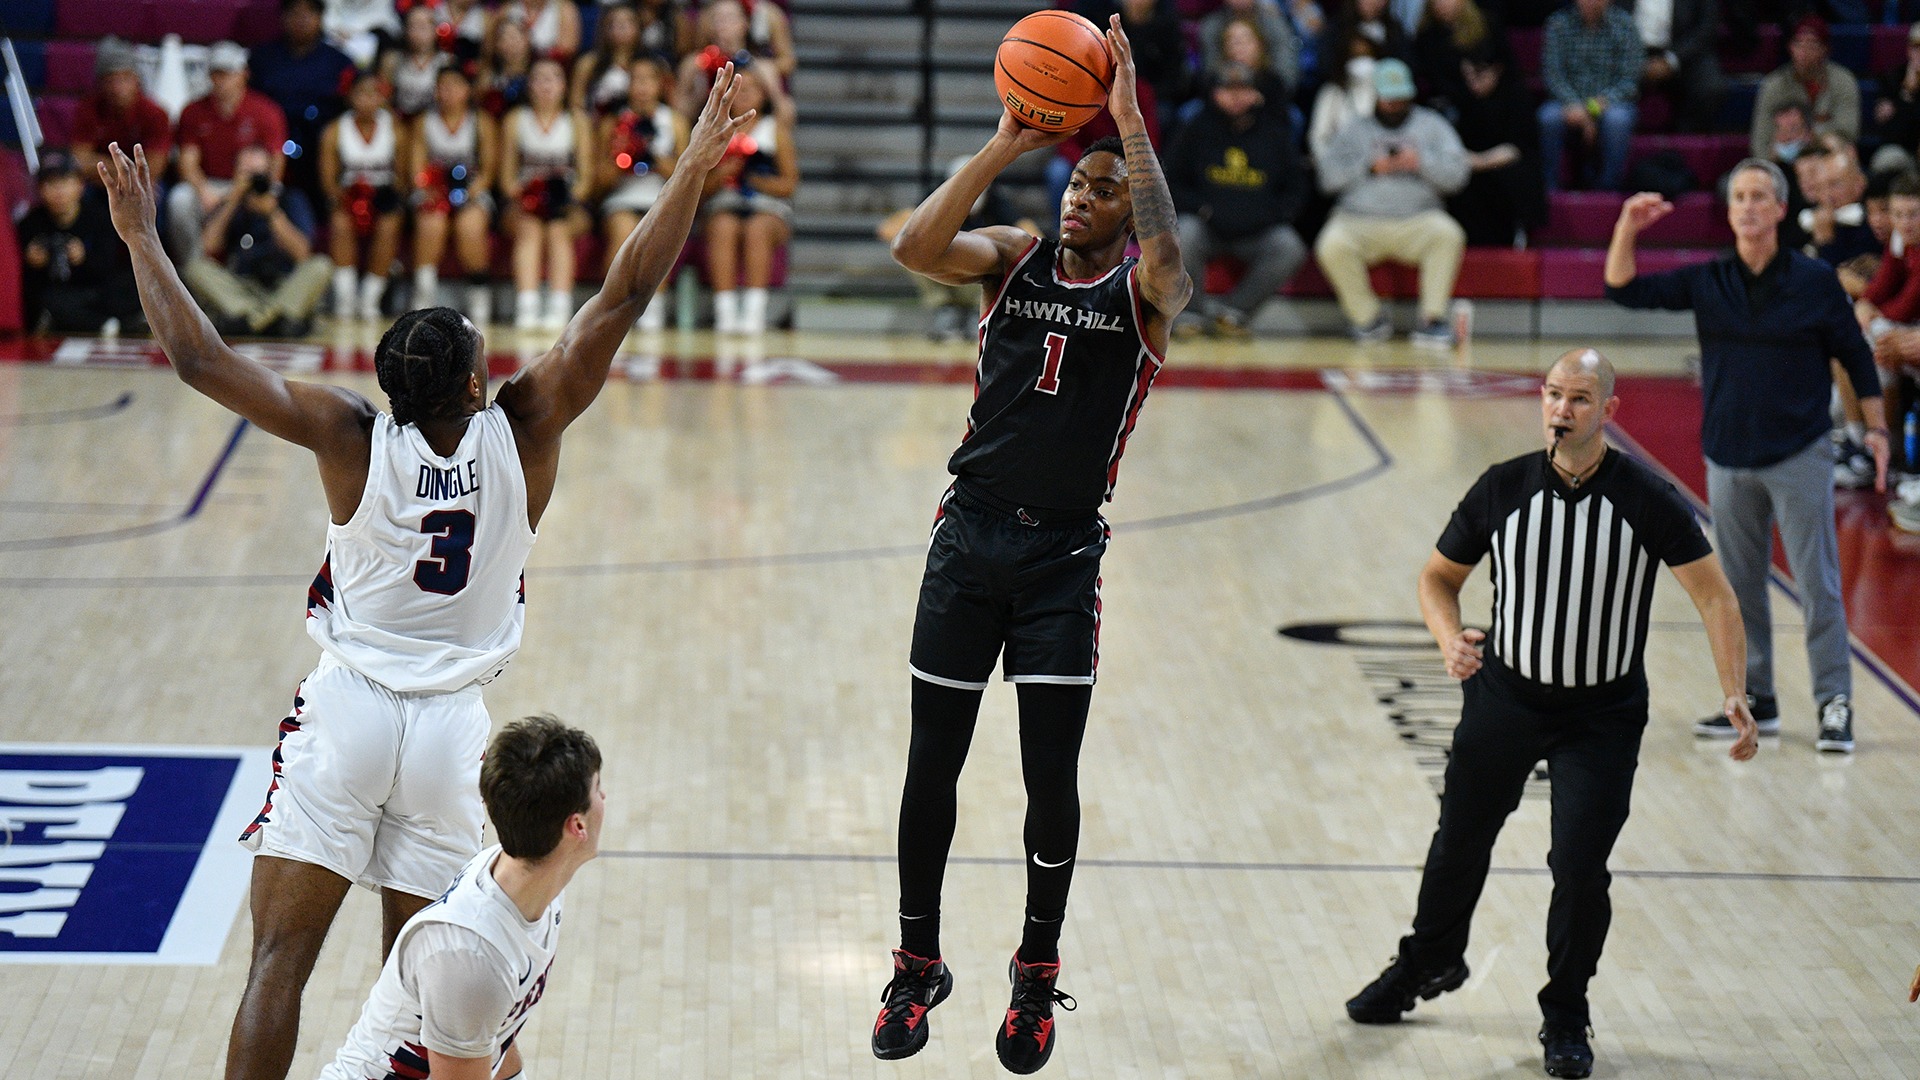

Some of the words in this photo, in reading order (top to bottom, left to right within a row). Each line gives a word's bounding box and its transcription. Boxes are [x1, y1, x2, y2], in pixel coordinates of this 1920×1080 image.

[1006, 91, 1065, 126] ELITE
[1005, 296, 1072, 325] HAWK
[1074, 309, 1124, 332] HILL
[1034, 332, 1067, 395] 1
[416, 459, 480, 500] DINGLE
[413, 509, 476, 596] 3
